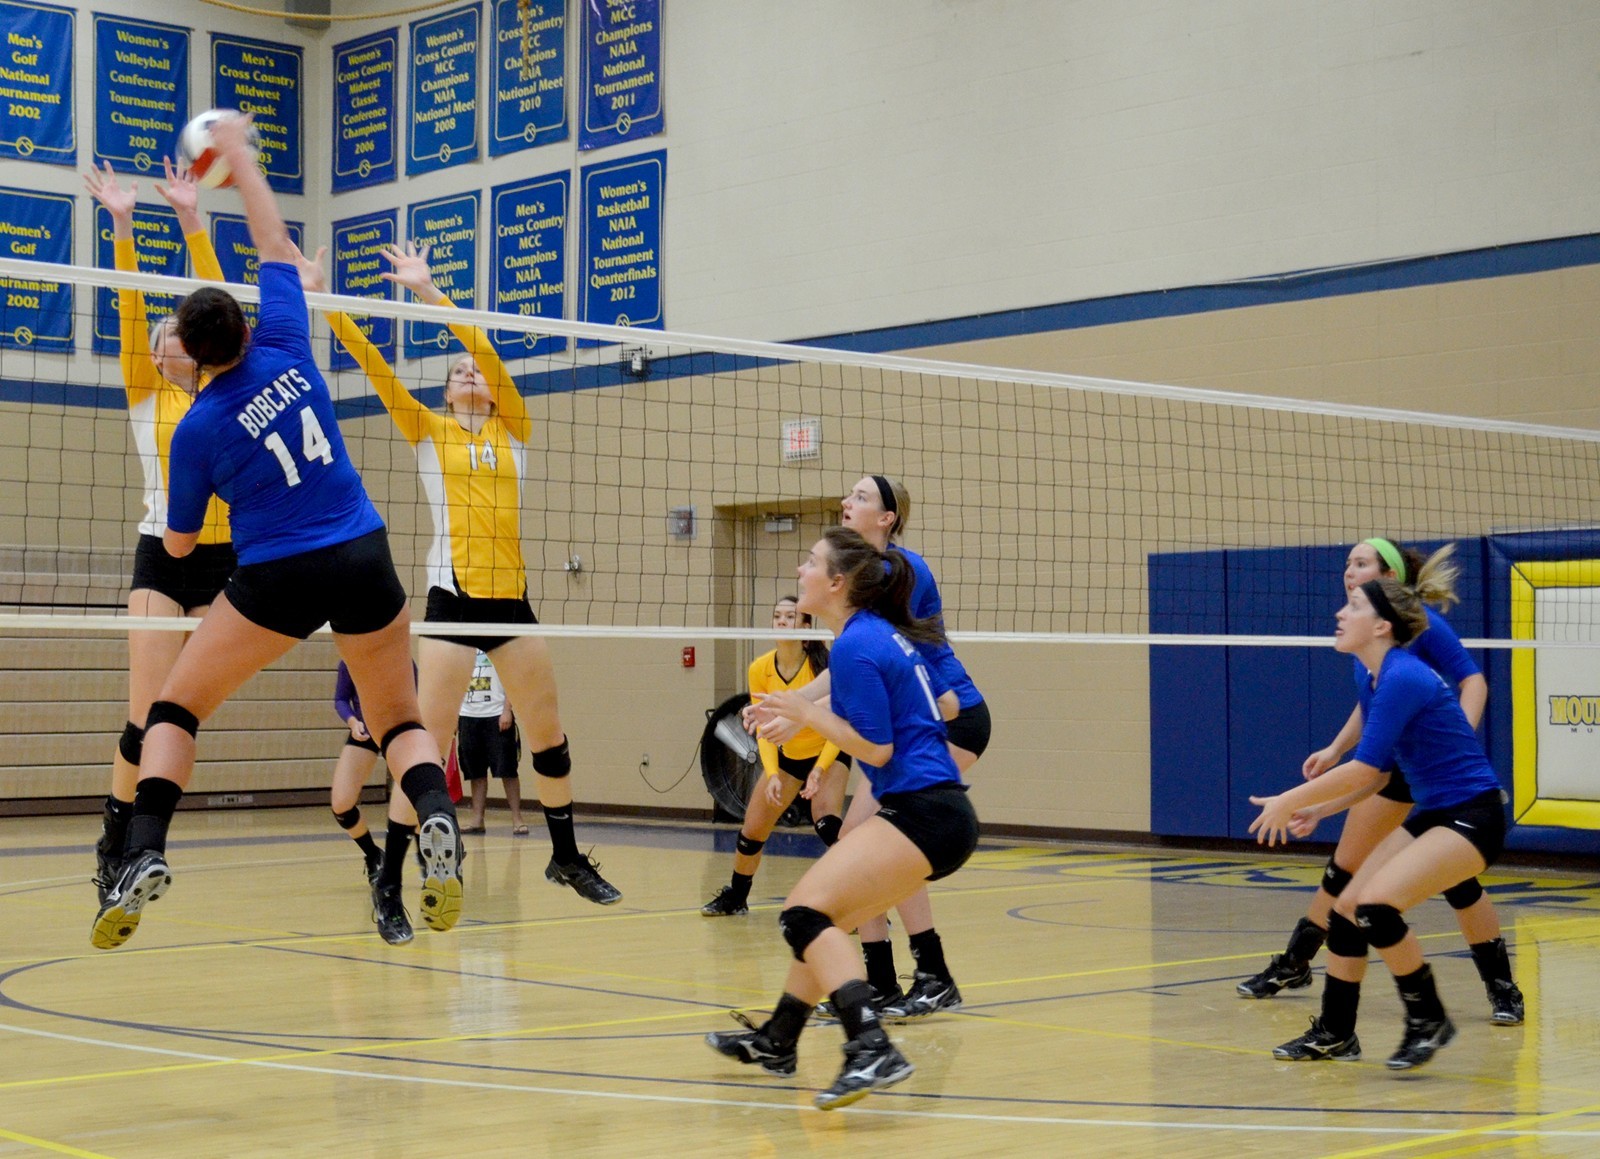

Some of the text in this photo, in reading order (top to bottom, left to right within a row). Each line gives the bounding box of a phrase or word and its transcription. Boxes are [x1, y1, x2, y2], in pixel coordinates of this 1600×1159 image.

[517, 4, 544, 21] Mn's
[611, 6, 636, 24] MCC
[528, 16, 564, 35] Country
[596, 21, 653, 45] Champions
[8, 33, 43, 49] Men's
[117, 30, 169, 49] Women's
[426, 28, 464, 48] Women's
[348, 49, 381, 66] Women's
[416, 42, 476, 66] Cross Country
[609, 41, 638, 59] NAIA
[12, 52, 38, 66] Golf
[115, 51, 170, 70] Volleyball
[242, 52, 275, 67] Men's
[603, 56, 645, 78] National
[0, 67, 50, 86] National
[338, 61, 393, 84] Cross Country
[435, 61, 455, 75] MCC
[110, 70, 175, 91] Conference
[220, 65, 295, 89] Cross Country
[421, 72, 469, 93] Champions
[594, 72, 654, 97] Tournament
[0, 87, 61, 104] ournament
[235, 84, 280, 101] Midwest
[349, 79, 381, 95] Midwest
[499, 77, 564, 103] National Meet
[109, 91, 175, 112] Tournament
[351, 93, 378, 108] Classic
[434, 88, 456, 104] NAIA
[611, 94, 635, 111] 2011
[9, 104, 41, 119] 2002
[240, 101, 277, 116] Classic
[416, 99, 475, 123] National Meet
[519, 97, 541, 113] 2010
[111, 112, 174, 132] Champions
[343, 107, 387, 125] Conference
[343, 121, 387, 139] Champions
[129, 135, 157, 149] 2002
[600, 180, 647, 199] Women's
[515, 201, 545, 218] Men's
[597, 196, 650, 218] Basketball
[0, 222, 51, 239] Women's
[132, 220, 170, 233] omen's
[425, 214, 463, 231] Women's
[498, 215, 564, 237] Cross Country
[609, 216, 637, 233] NAIA
[137, 235, 182, 254] Country
[347, 228, 380, 244] Women's
[414, 228, 475, 249] Cross Country
[519, 234, 542, 250] MCC
[601, 231, 644, 251] National
[11, 241, 37, 255] Golf
[337, 247, 360, 260] Cross
[433, 244, 453, 260] MCC
[136, 253, 167, 266] west
[347, 259, 380, 274] Midwest
[430, 259, 468, 276] ampions
[504, 249, 557, 271] Champions
[593, 248, 654, 270] Tournament
[345, 273, 383, 289] Collegiate
[433, 274, 454, 289] NAIA
[516, 269, 541, 284] NAIA
[590, 265, 657, 289] Quarterfinals
[0, 279, 59, 293] urnament
[451, 287, 474, 301] Meet
[498, 281, 564, 304] National Meet
[610, 285, 636, 302] 2012
[7, 294, 39, 309] 2002
[519, 301, 541, 315] 2011
[237, 368, 312, 439] BOBCATS
[264, 405, 334, 487] 14
[466, 440, 497, 471] 14
[1549, 695, 1600, 725] MOU
